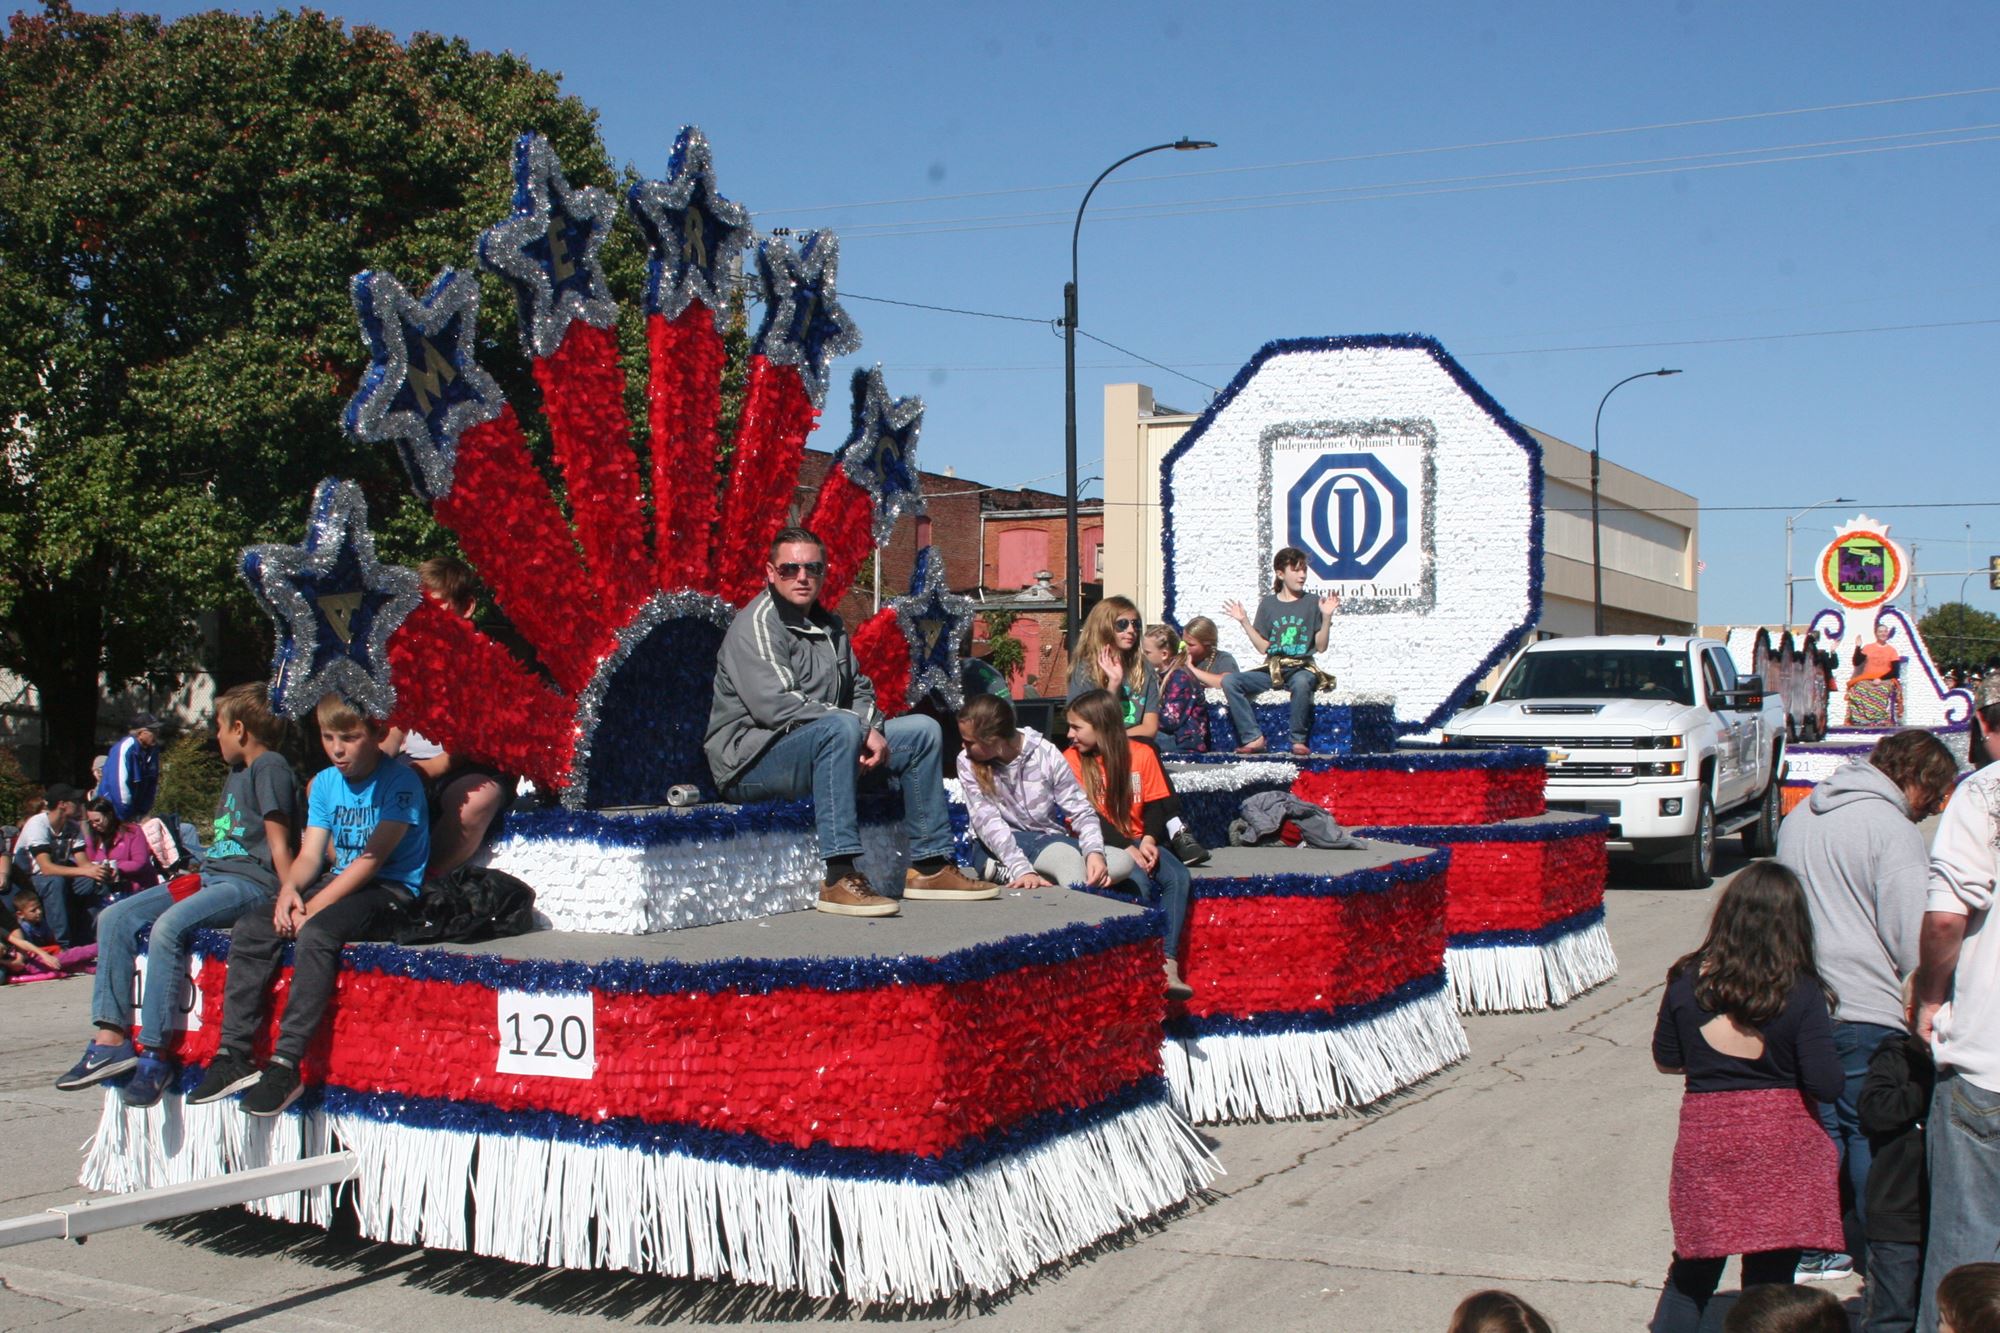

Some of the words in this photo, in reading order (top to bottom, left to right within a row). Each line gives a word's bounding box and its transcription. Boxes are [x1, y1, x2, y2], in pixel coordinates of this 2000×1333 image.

[1274, 437, 1346, 453] Independence
[1349, 436, 1393, 451] Optimist
[1397, 435, 1421, 447] Club
[1351, 583, 1367, 597] of
[506, 1012, 587, 1060] 120
